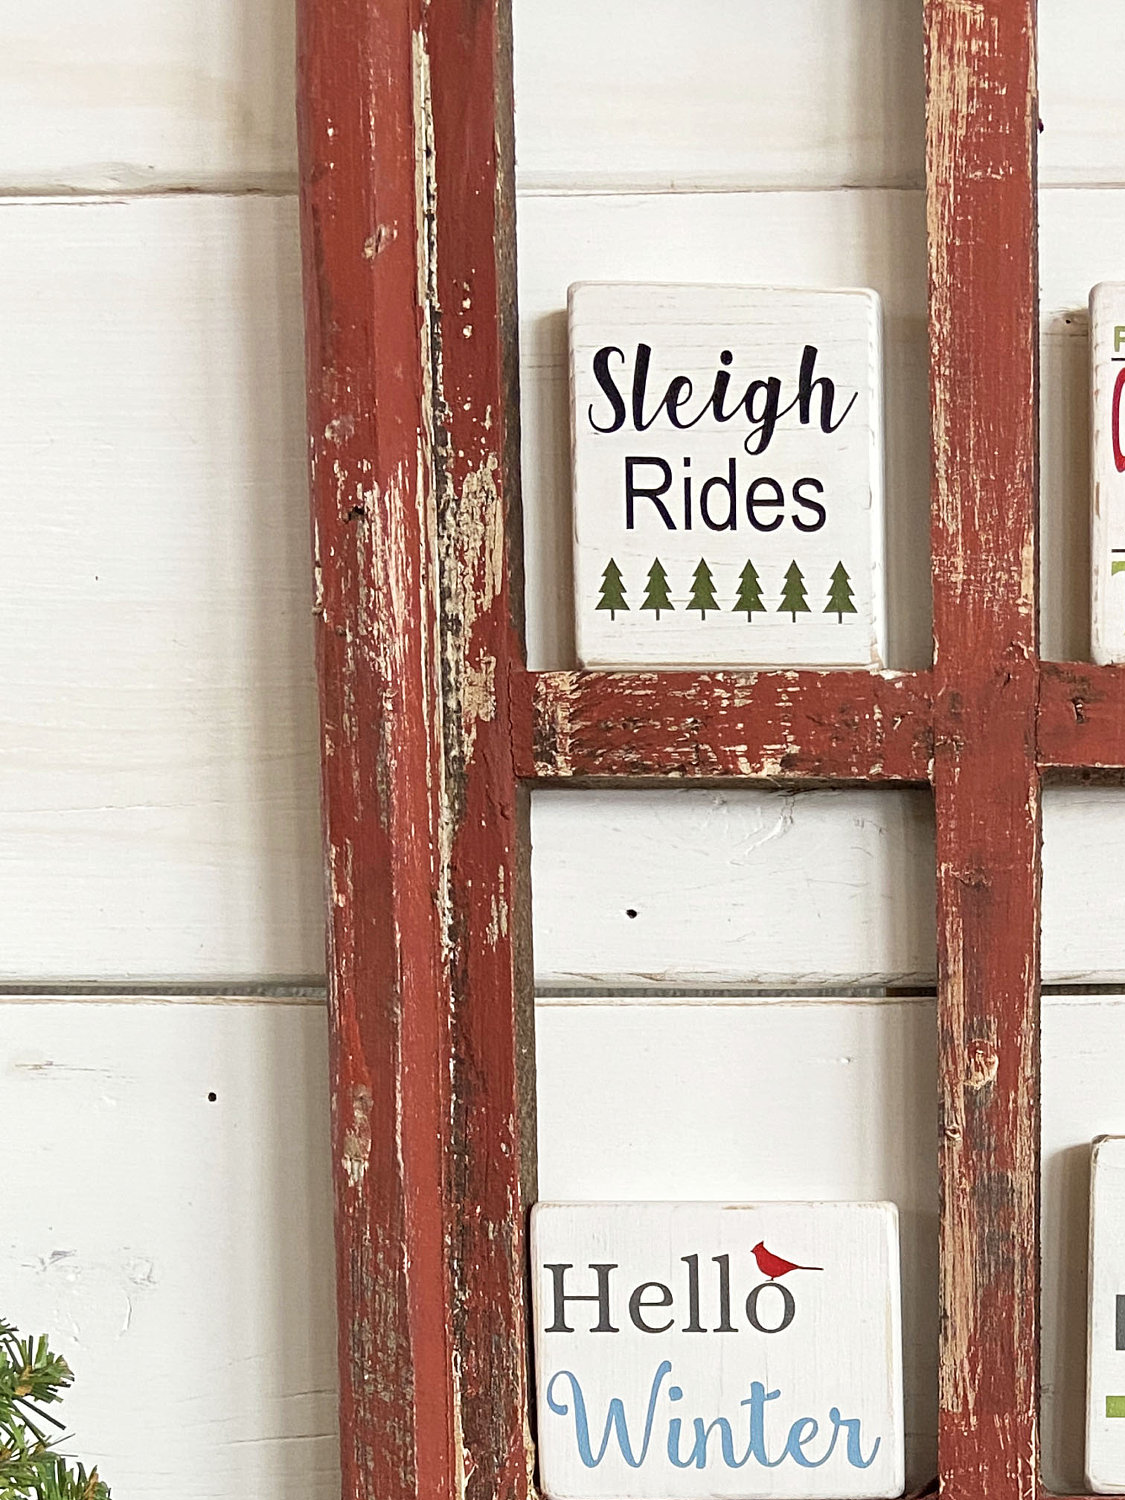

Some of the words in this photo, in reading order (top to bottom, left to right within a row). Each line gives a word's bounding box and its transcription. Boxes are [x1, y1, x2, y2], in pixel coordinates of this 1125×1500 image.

[588, 343, 858, 456] Sleigh
[622, 455, 828, 534] Rides
[543, 1254, 797, 1333] Hello
[546, 1360, 881, 1470] Winter
